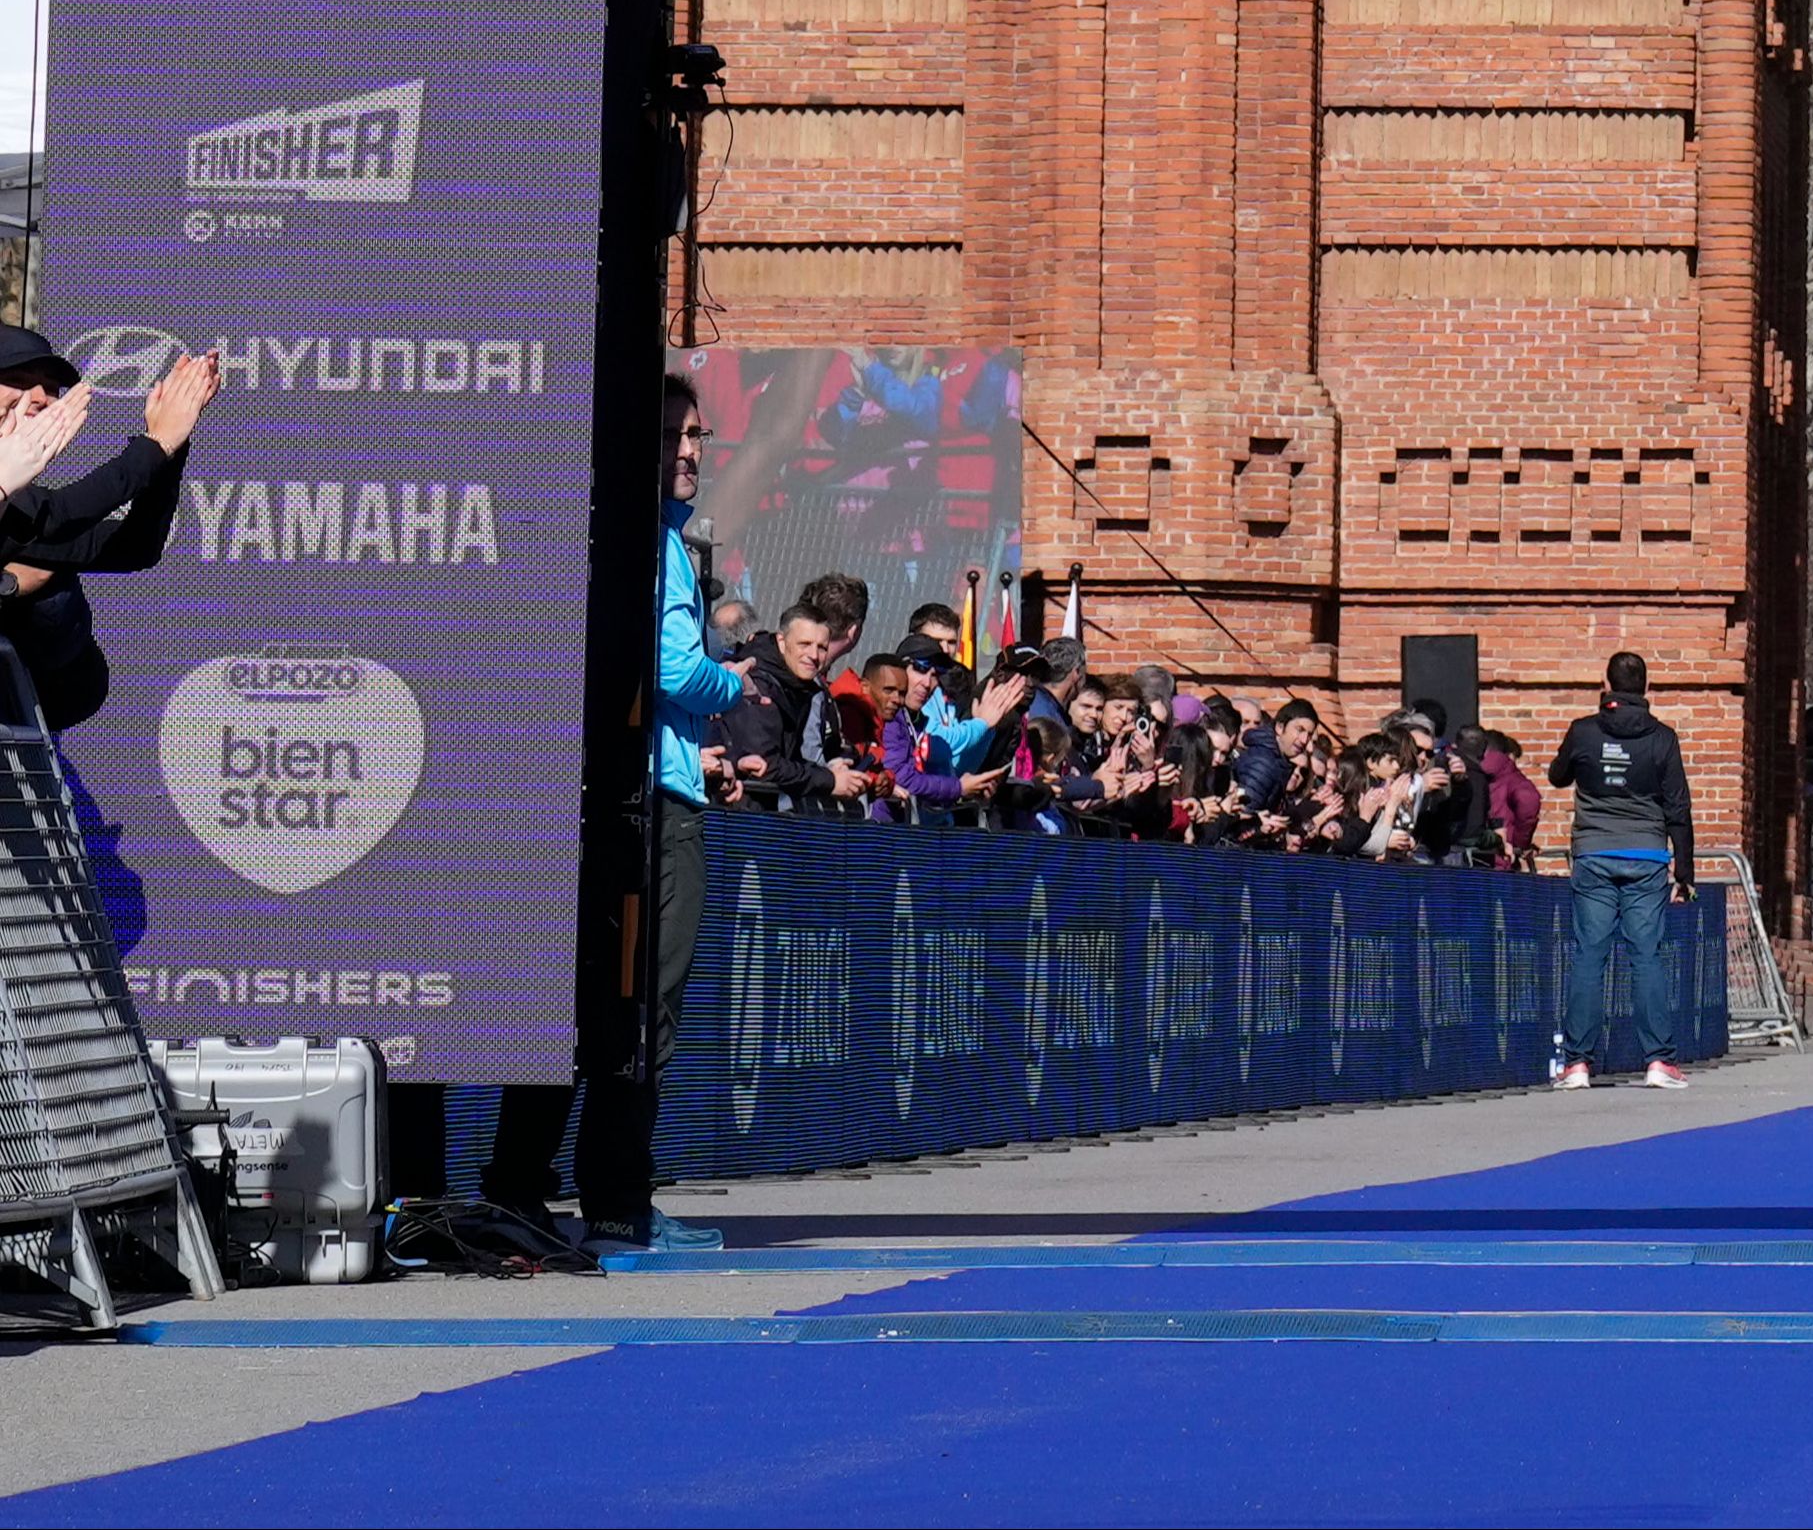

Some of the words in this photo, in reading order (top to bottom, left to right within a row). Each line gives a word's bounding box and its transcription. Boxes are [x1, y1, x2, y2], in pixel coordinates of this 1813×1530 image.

[193, 107, 402, 182] FINISHER
[214, 338, 544, 394] HYUNDAI
[190, 481, 498, 564] YAMAHA
[220, 725, 360, 781] bien
[219, 784, 349, 830] star
[126, 969, 454, 1006] FINISHERS
[236, 1132, 286, 1151] META
[594, 1221, 634, 1238] HOKA
